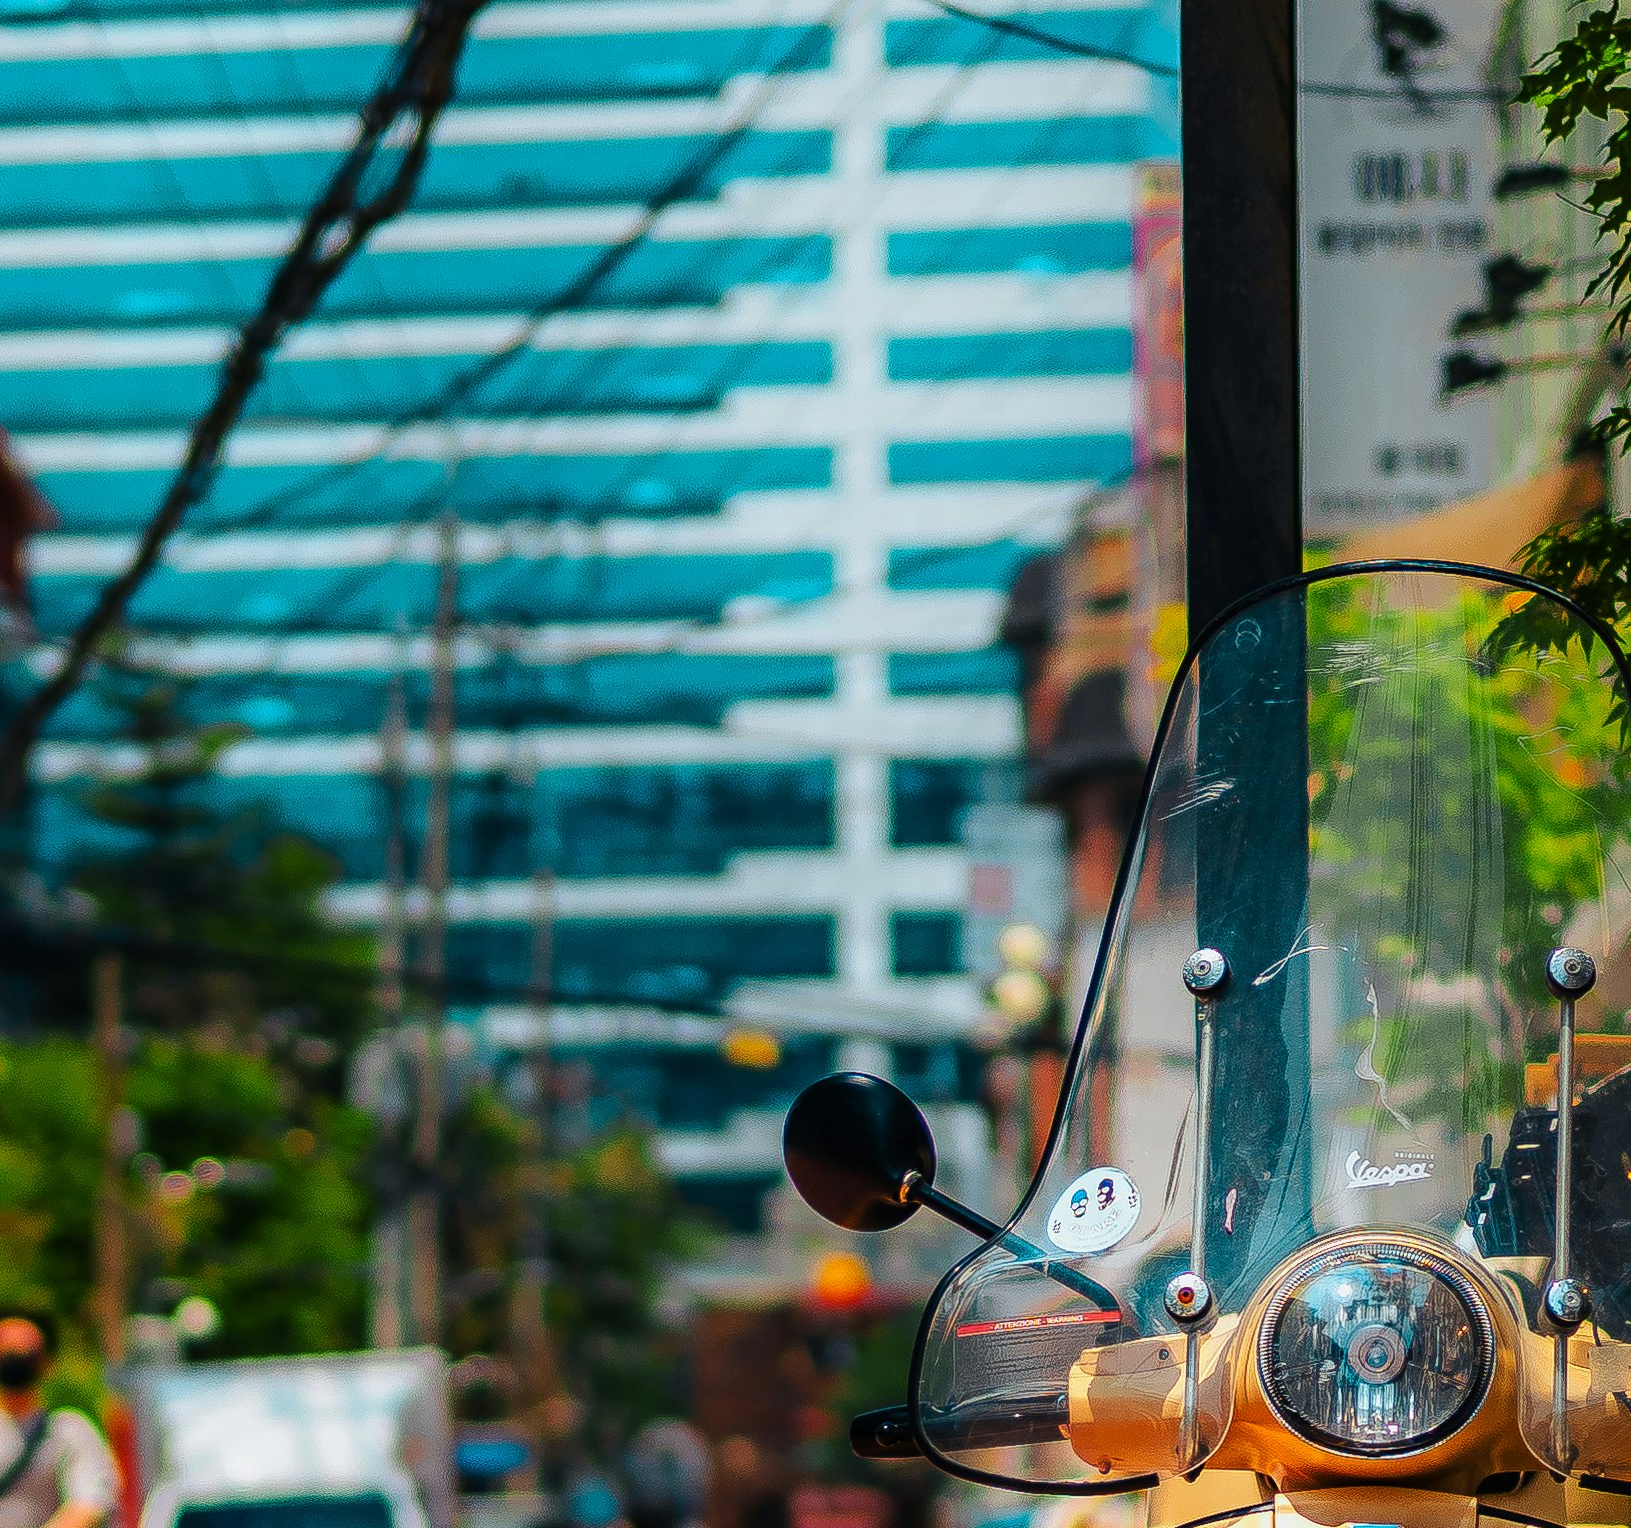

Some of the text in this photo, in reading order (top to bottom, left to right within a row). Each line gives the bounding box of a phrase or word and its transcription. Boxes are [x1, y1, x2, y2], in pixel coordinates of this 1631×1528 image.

[1345, 1149, 1432, 1188] Vespa
[994, 1314, 1084, 1330] ATTENZIONE WARNING
